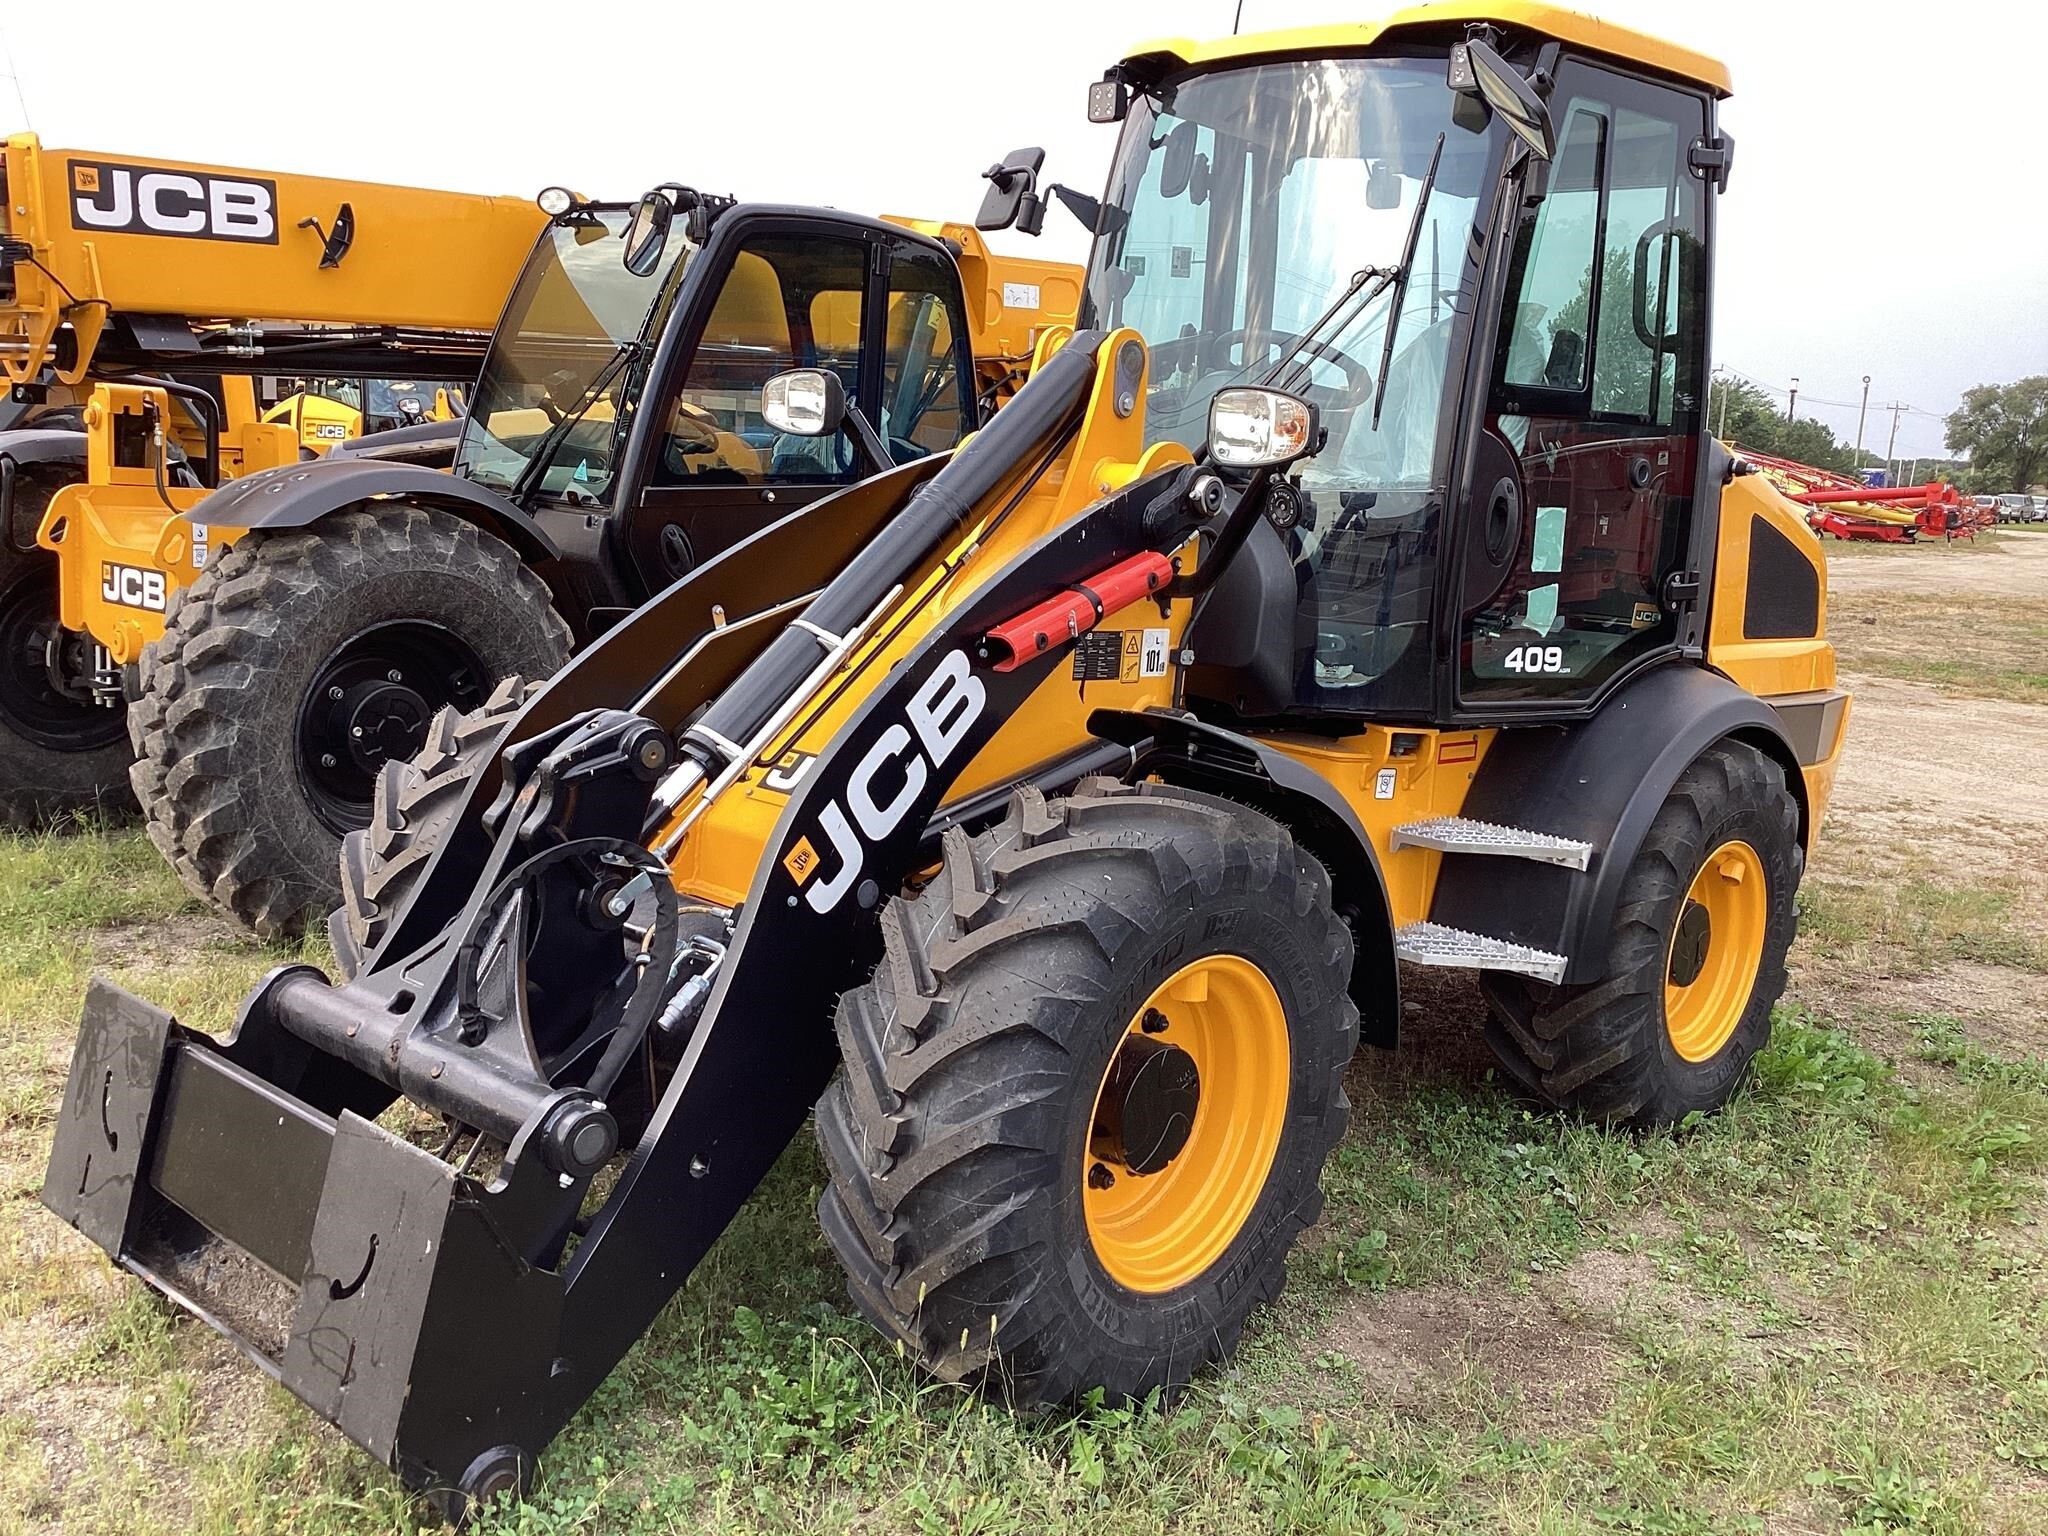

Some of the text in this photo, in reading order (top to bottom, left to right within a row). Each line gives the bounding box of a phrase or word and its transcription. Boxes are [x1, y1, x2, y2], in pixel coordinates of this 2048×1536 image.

[76, 169, 274, 238] JCB
[317, 425, 345, 438] JCB
[103, 565, 166, 610] JCB
[1145, 649, 1161, 673] 101
[1504, 646, 1563, 673] 409
[805, 649, 986, 914] JCB
[793, 850, 810, 871] JCB
